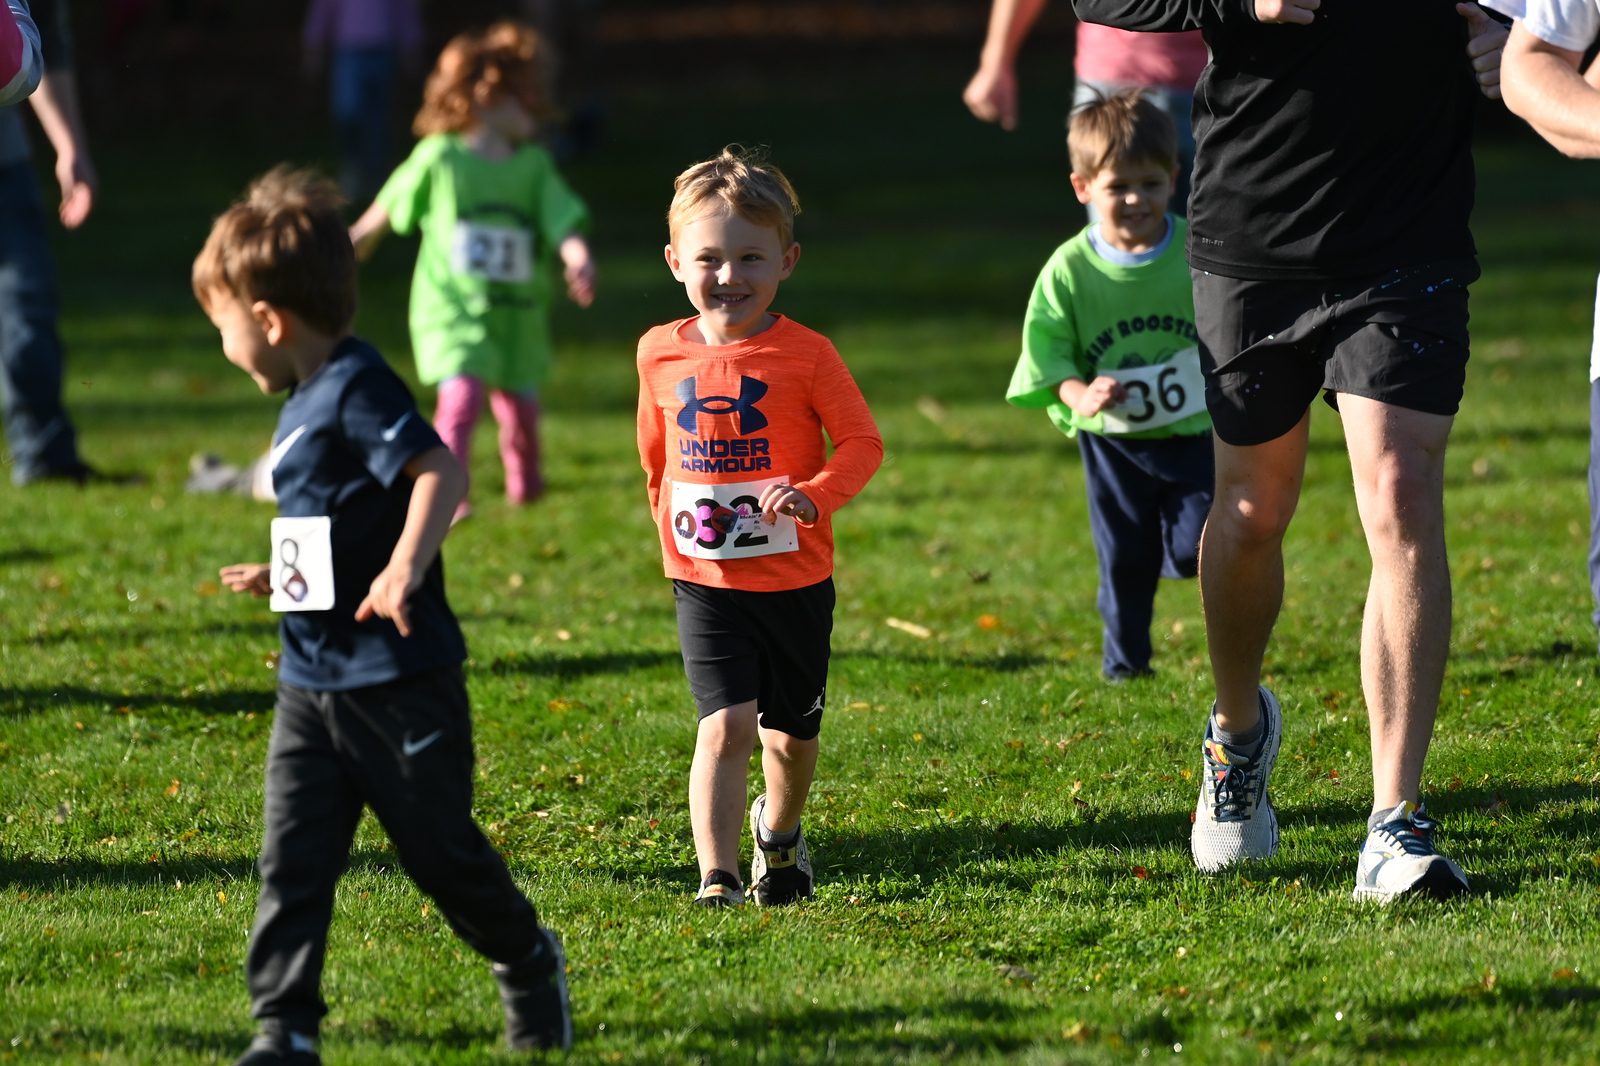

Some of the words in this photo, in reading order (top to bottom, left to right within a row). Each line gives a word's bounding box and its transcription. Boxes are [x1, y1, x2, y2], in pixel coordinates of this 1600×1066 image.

[1123, 367, 1186, 423] 36
[679, 438, 770, 458] UNDER
[681, 457, 772, 473] ARMOUR
[694, 495, 769, 549] 32
[279, 538, 309, 603] 8
